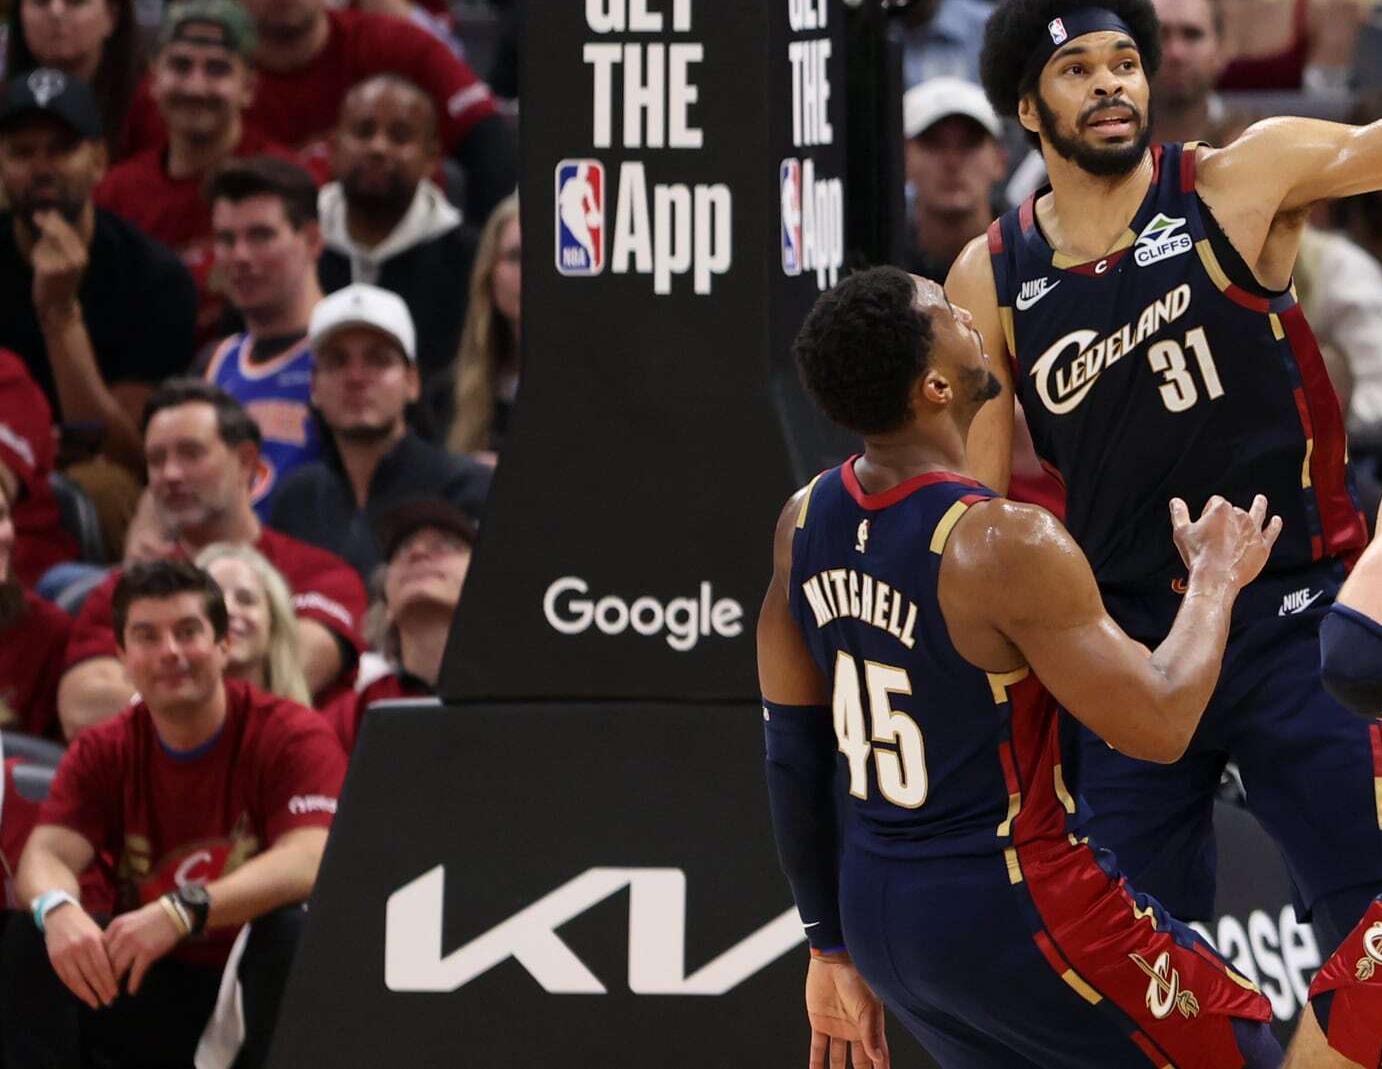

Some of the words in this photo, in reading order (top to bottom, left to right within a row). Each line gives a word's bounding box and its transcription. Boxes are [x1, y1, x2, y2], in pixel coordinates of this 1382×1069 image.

[583, 42, 704, 149] THE
[788, 38, 832, 148] THE
[611, 161, 732, 295] App
[801, 157, 843, 292] App
[1138, 237, 1190, 262] CLIFFS
[1021, 276, 1048, 299] NIKE
[1029, 283, 1192, 415] CLEVELAND
[1147, 325, 1226, 413] 31
[543, 576, 744, 651] Google
[802, 568, 918, 649] MITCHELL
[1283, 587, 1310, 612] NIKE
[832, 649, 928, 810] 45
